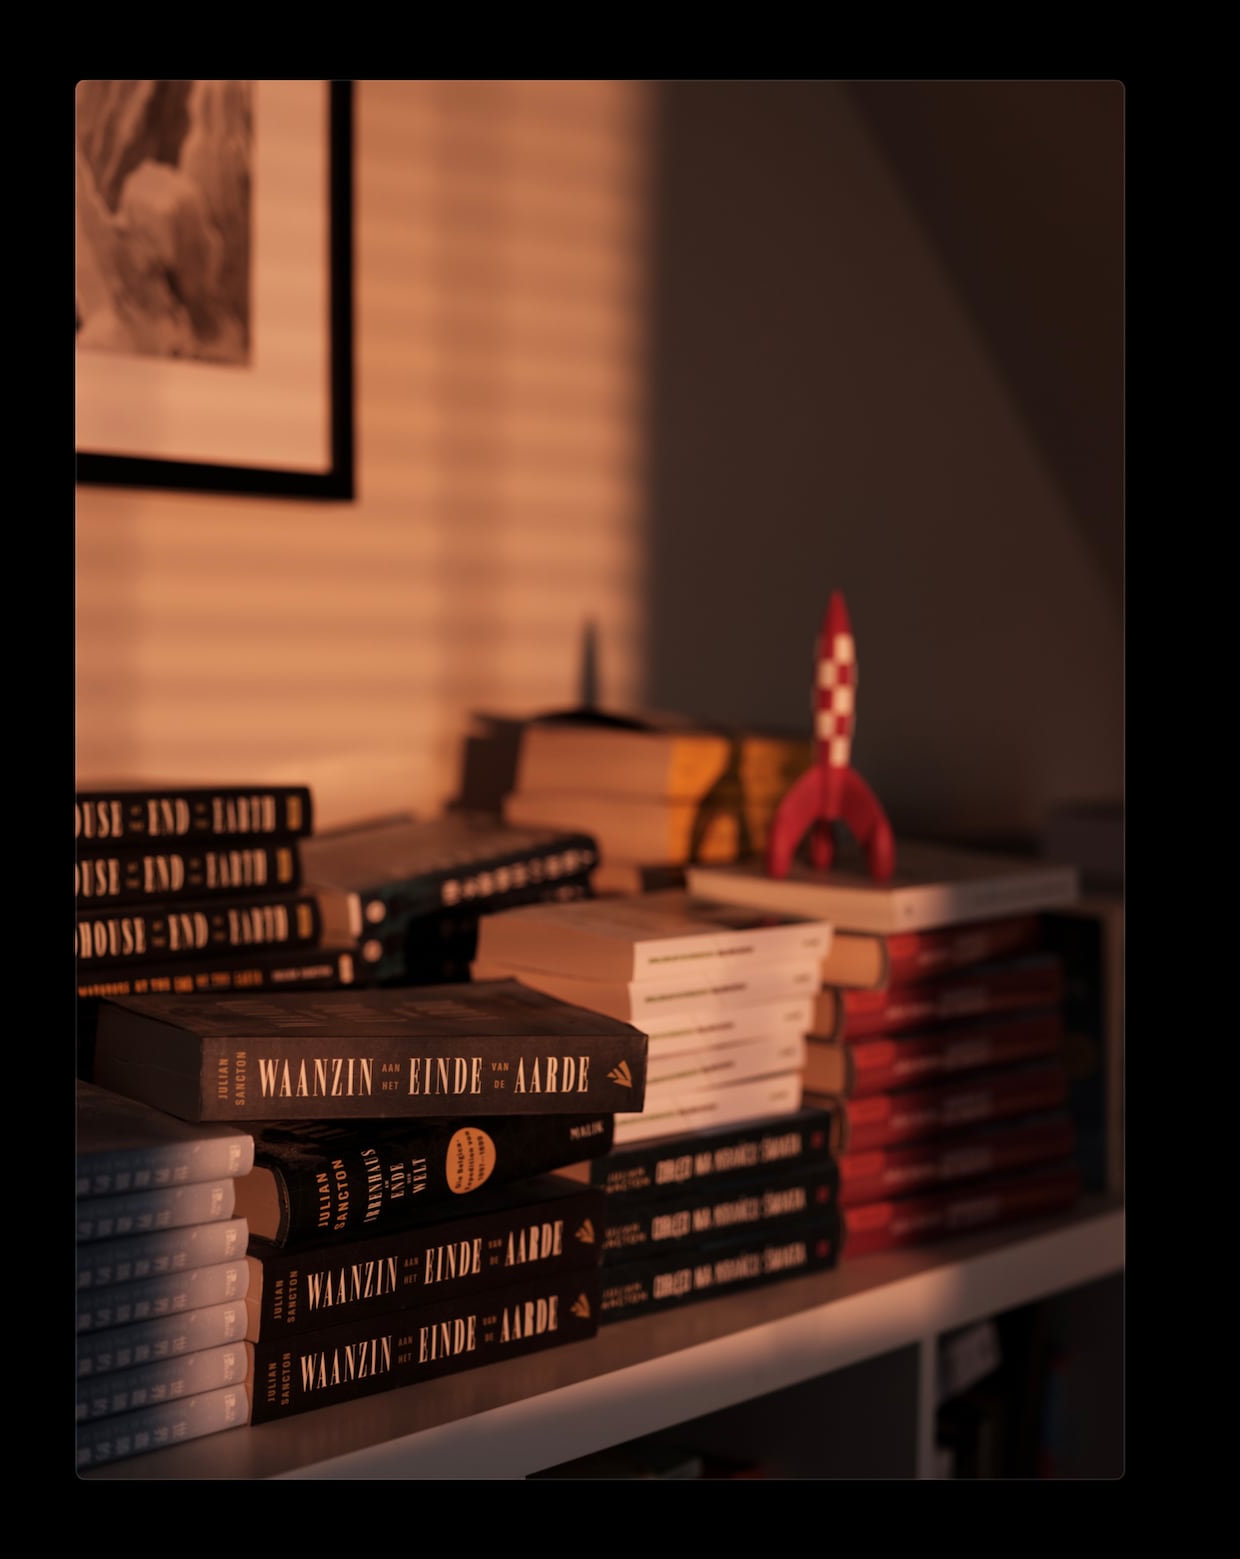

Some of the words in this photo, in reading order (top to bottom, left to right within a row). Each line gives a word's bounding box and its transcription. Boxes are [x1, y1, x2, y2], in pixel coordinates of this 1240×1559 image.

[218, 1058, 229, 1100] JULIAN
[235, 1051, 247, 1106] SANCTON
[258, 1057, 374, 1097] WAANZIN
[381, 1063, 401, 1073] AAN
[381, 1081, 399, 1091] HET
[408, 1057, 483, 1096] EINDE
[491, 1062, 509, 1071] VAN
[494, 1080, 505, 1089] DE
[513, 1055, 590, 1094] AARDE
[331, 1159, 350, 1231] SANCTON
[360, 1148, 383, 1224] IRRENHAUS
[389, 1162, 405, 1199] ENDE
[411, 1157, 427, 1194] WELT
[315, 1172, 331, 1228] JULIAN
[423, 1237, 483, 1285] EINDE
[504, 1219, 564, 1267] AARDE
[273, 1279, 284, 1320] JULIAN
[287, 1269, 299, 1324] SANCTON
[306, 1255, 399, 1312] WAANZIN
[417, 1314, 478, 1364] EINDE
[499, 1294, 559, 1344] AARDE
[267, 1361, 277, 1402] JULIAN
[280, 1352, 292, 1406] SANCTON
[300, 1335, 393, 1393] WAANZIN
